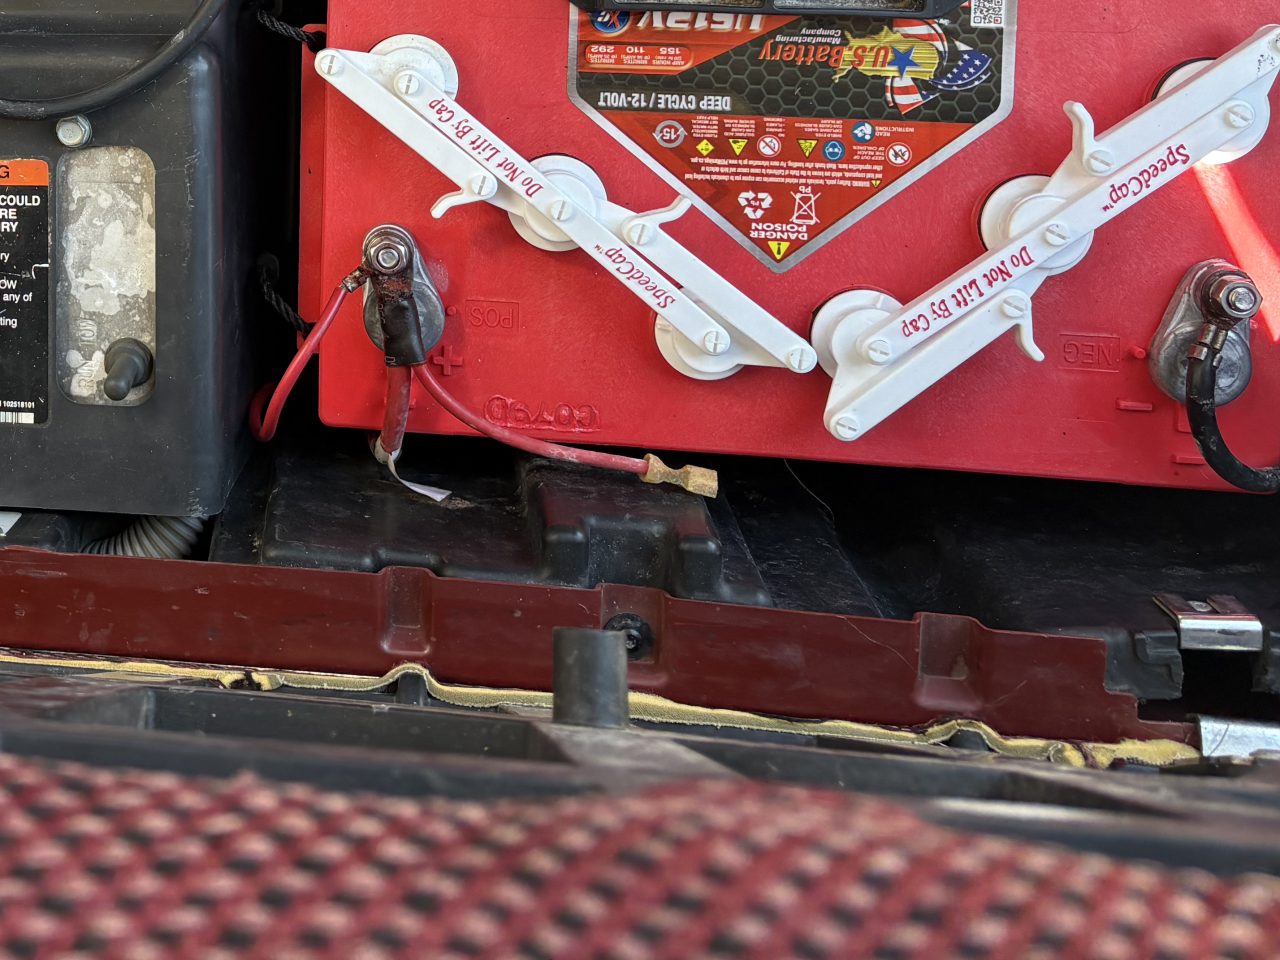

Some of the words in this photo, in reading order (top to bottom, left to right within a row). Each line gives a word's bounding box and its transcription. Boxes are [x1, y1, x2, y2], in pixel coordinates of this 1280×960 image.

[776, 34, 841, 45] Manufacturing
[801, 27, 841, 37] Company
[597, 91, 648, 109] 12-VOLT
[656, 93, 696, 110] CYCLE
[699, 94, 731, 112] DEEP
[428, 98, 455, 126] Cap
[450, 115, 473, 139] By
[469, 137, 502, 166] Lift
[495, 153, 526, 184] Not
[519, 174, 542, 198] Do
[749, 229, 808, 241] DANGER
[750, 221, 807, 232] POISON
[1009, 245, 1034, 269] Do
[979, 261, 1011, 287] Not
[3, 293, 20, 303] any
[23, 292, 32, 301] of
[951, 278, 984, 306] Lift
[929, 301, 952, 322] By
[902, 310, 931, 337] Cap
